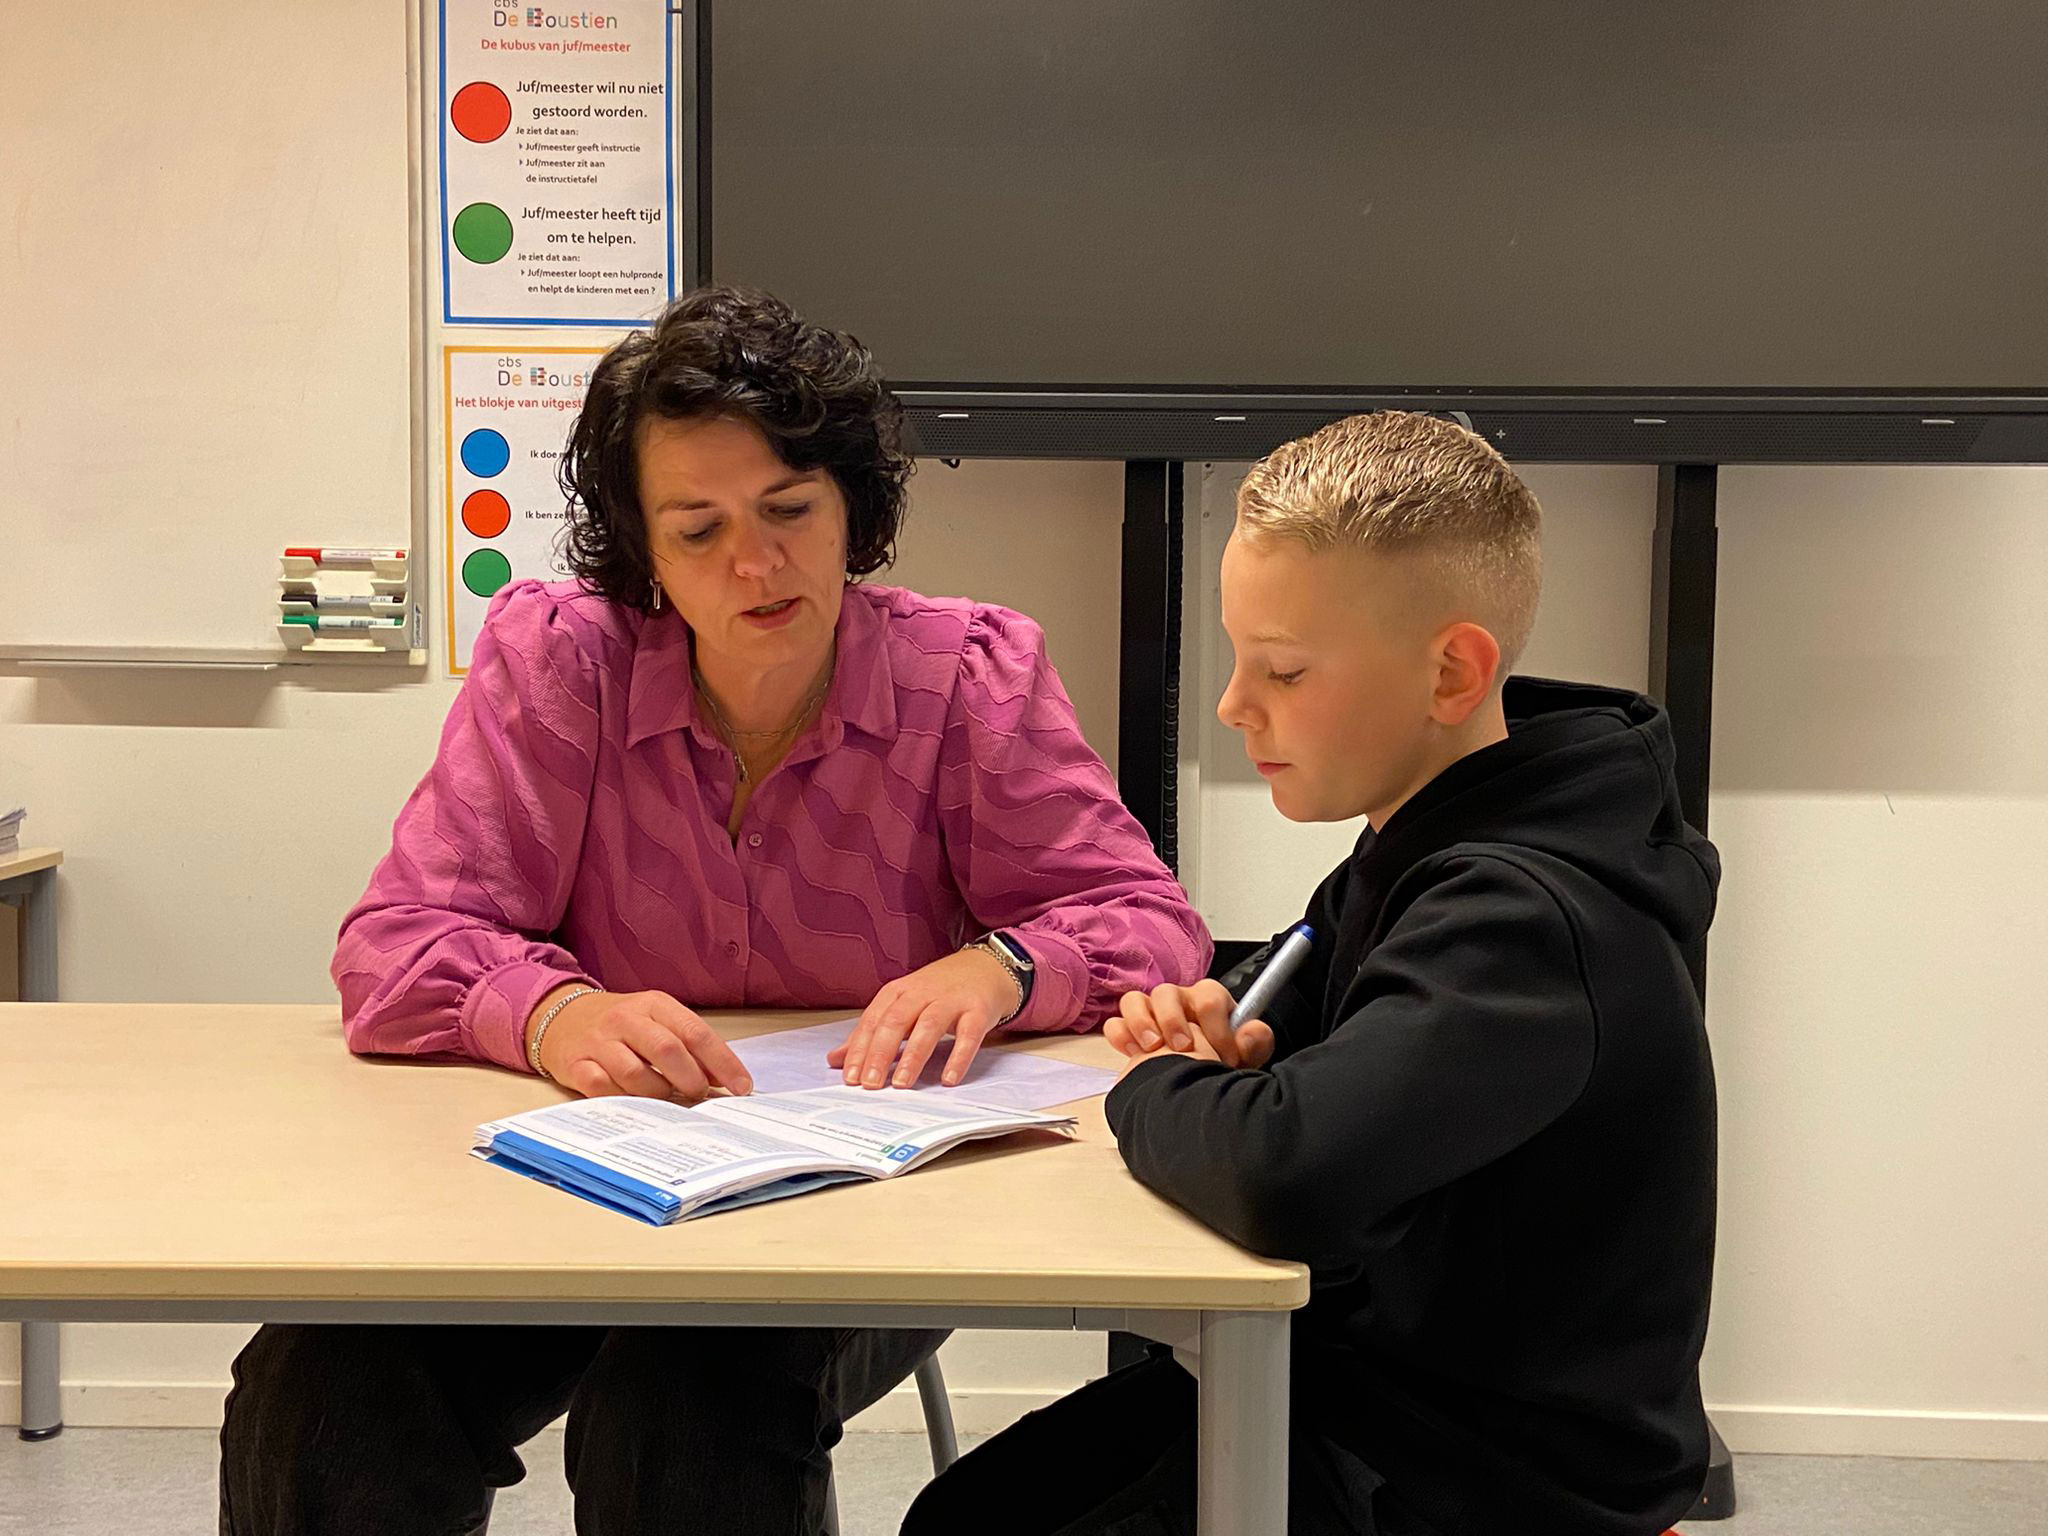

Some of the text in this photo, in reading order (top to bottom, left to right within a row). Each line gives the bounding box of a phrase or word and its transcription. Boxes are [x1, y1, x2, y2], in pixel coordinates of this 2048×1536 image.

[494, 8, 617, 28] De Boustien
[482, 38, 631, 54] De kubus van juf/meester
[516, 80, 663, 95] Juf/meester wil nu niet
[533, 105, 647, 119] gestoord worden.
[516, 125, 579, 136] Je ziet dat aan:
[526, 142, 641, 155] Juf/meester geeft instructie
[526, 157, 606, 168] Juf/meester zit aan
[526, 173, 598, 184] de instructietafel
[522, 207, 660, 224] Juf/meester heeft tijd
[547, 232, 636, 246] om te helpen.
[518, 252, 527, 261] Je
[529, 252, 544, 262] ziet
[546, 252, 561, 262] dat
[528, 267, 664, 281] Juf/meester loopt een hulpronde
[528, 285, 539, 293] en
[540, 284, 563, 295] helpt
[564, 284, 575, 294] de
[577, 284, 614, 295] kinderen
[615, 287, 633, 295] met
[634, 287, 650, 295] een
[498, 355, 522, 368] cbs
[498, 367, 591, 387] De Boust
[456, 396, 584, 411] Het blokje van uitgest
[531, 449, 539, 459] Ik
[541, 449, 558, 459] doe
[526, 510, 534, 519] Ik
[536, 510, 553, 520] ben
